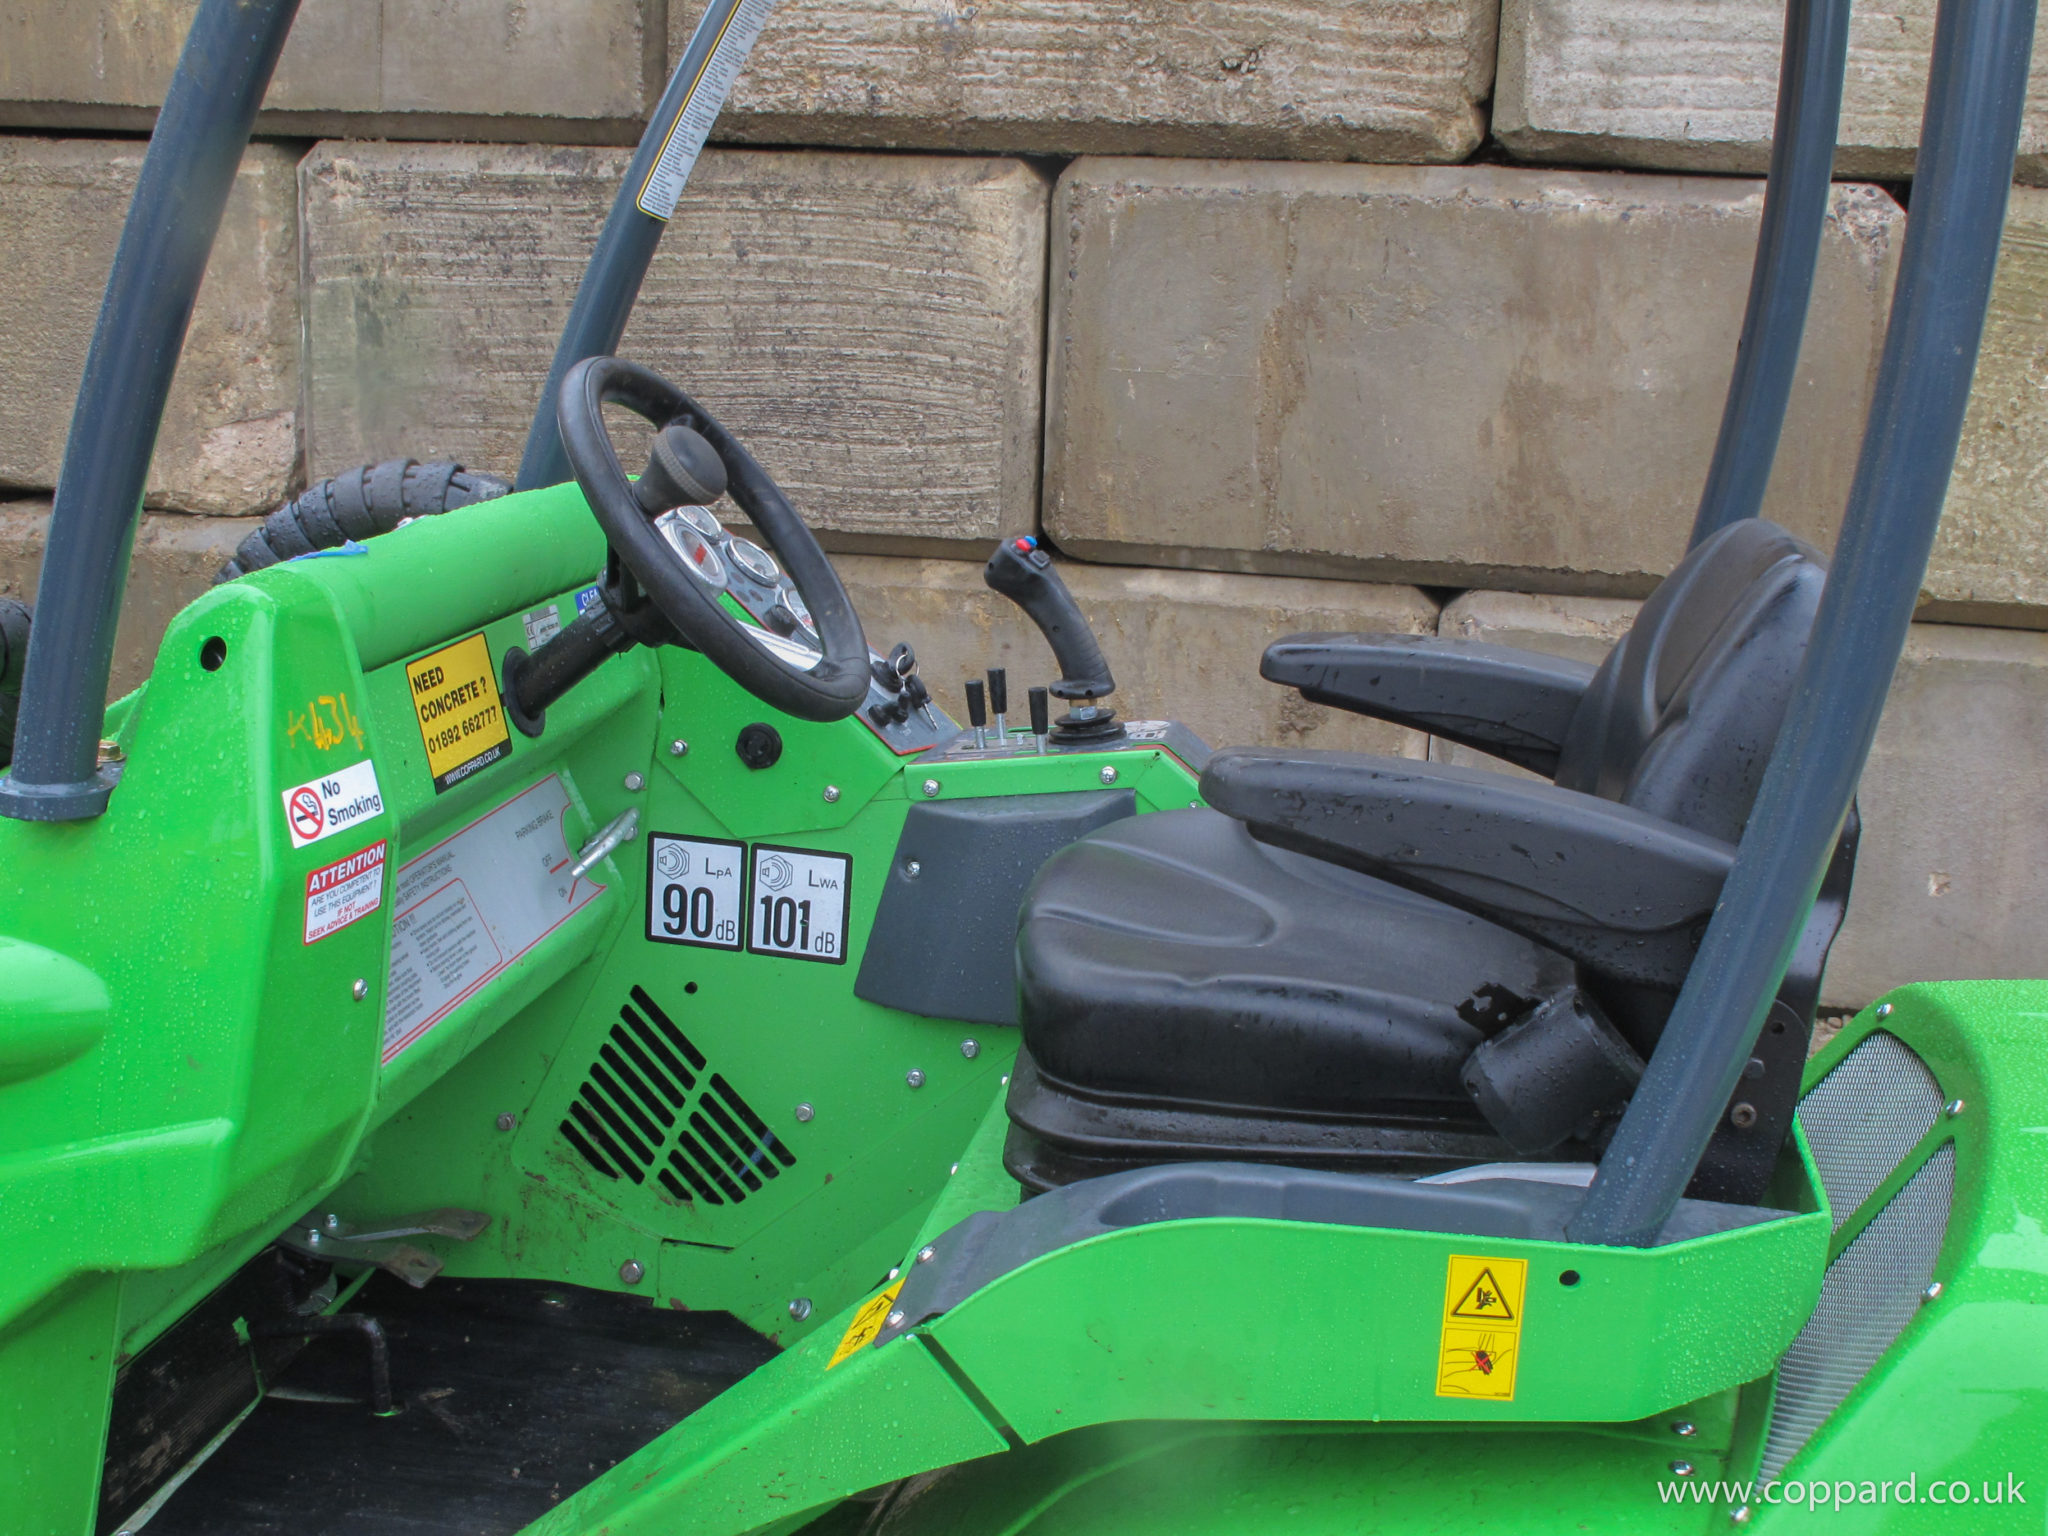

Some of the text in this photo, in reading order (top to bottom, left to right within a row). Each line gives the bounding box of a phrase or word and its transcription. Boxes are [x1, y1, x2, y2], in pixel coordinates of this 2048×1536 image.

[412, 666, 444, 695] NEED
[420, 676, 487, 723] CONCRETE ?
[428, 705, 497, 754] 01892 662777
[444, 746, 502, 785] WWW.COPPARD.CO.UK
[321, 780, 340, 799] No
[328, 794, 381, 826] Smoking
[309, 843, 385, 893] ATTENTION
[311, 867, 380, 906] ARE YOU COMPETENT TO
[705, 857, 732, 879] LpA
[308, 927, 326, 939] SEEK
[326, 914, 348, 930] ADVICE
[354, 897, 379, 917] TRAINING
[314, 906, 327, 917] USE
[328, 899, 341, 911] THIS
[342, 882, 373, 904] EQUIPMENT
[337, 901, 356, 916] IF NOT
[662, 883, 736, 941] 90 dB
[760, 895, 835, 954] 101 dB
